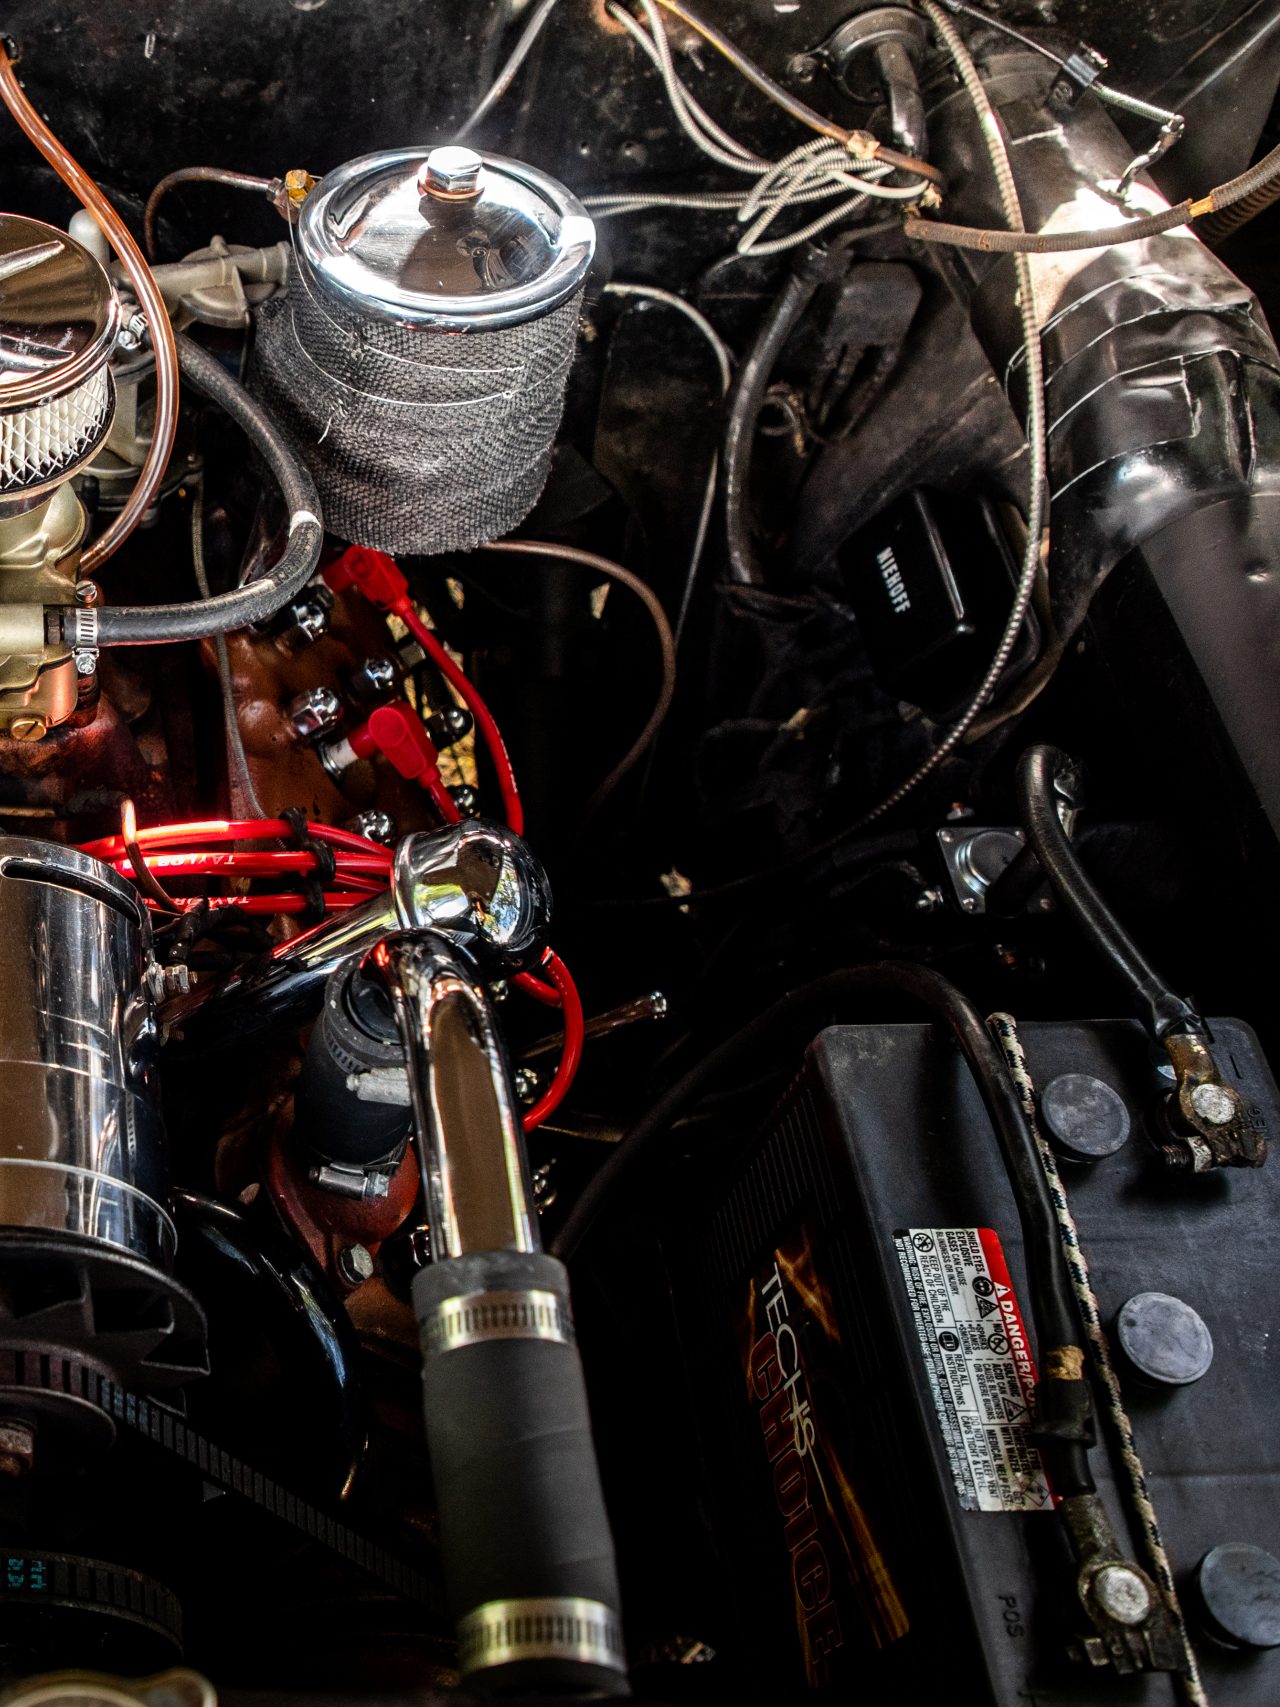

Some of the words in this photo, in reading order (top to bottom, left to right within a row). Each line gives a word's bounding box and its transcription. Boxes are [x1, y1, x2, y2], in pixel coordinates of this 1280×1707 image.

[876, 546, 911, 614] NIEHOFF
[157, 853, 236, 868] TAYLOR
[894, 1238, 906, 1251] NOT
[946, 1231, 959, 1252] GASES
[956, 1231, 974, 1267] EXPLOSIVE
[966, 1231, 980, 1254] SHIELD
[936, 1231, 951, 1263] BLINDNESS
[945, 1264, 954, 1273] OR
[952, 1253, 961, 1266] CAN
[919, 1255, 932, 1277] REACH
[929, 1255, 939, 1271] KEEP
[897, 1251, 917, 1298] RECOMMENDED
[910, 1266, 922, 1281] RISK
[925, 1278, 936, 1288] OF
[933, 1273, 944, 1287] OUT
[955, 1266, 968, 1287] CAUSE
[914, 1281, 924, 1291] OF
[937, 1288, 947, 1298] OF
[909, 1298, 920, 1311] FOR
[928, 1289, 945, 1326] CHILDREN.
[940, 1299, 951, 1312] THE
[913, 1311, 928, 1342] INVERTED
[921, 1307, 938, 1342] EXPLOSION
[993, 1323, 1004, 1333] NO
[930, 1342, 940, 1352] OR
[923, 1358, 939, 1385] FOLLOW
[954, 1354, 968, 1373] READ
[973, 1363, 983, 1373] OR
[983, 1363, 996, 1384] CAUSE
[991, 1363, 1005, 1381] ACID
[939, 1378, 949, 1388] DO
[945, 1354, 966, 1408] INSTRUCTIONS.
[959, 1374, 970, 1387] ALL
[975, 1374, 991, 1397] SEVERE
[997, 1381, 1008, 1395] CAN
[1002, 1363, 1021, 1398] SULFURIC
[931, 1386, 946, 1411] PROPER
[941, 1389, 953, 1402] NOT
[988, 1385, 1005, 1420] BLINDNESS
[937, 1412, 955, 1447] CHARGING
[945, 1402, 964, 1449] DISASSEMBLE
[960, 1415, 974, 1435] CAPS
[969, 1416, 980, 1425] DO
[973, 1428, 985, 1443] NOT
[1000, 1427, 1015, 1446] WITH
[966, 1437, 981, 1458] TIGHT
[986, 1429, 1003, 1462] MEDICAL
[995, 1463, 1010, 1482] HELP
[982, 1460, 994, 1479] KEEP
[1006, 1447, 1022, 1473] WATER
[751, 1330, 845, 1666] CHOICE
[987, 1480, 1000, 1499] VENT
[998, 1595, 1025, 1638] POS
